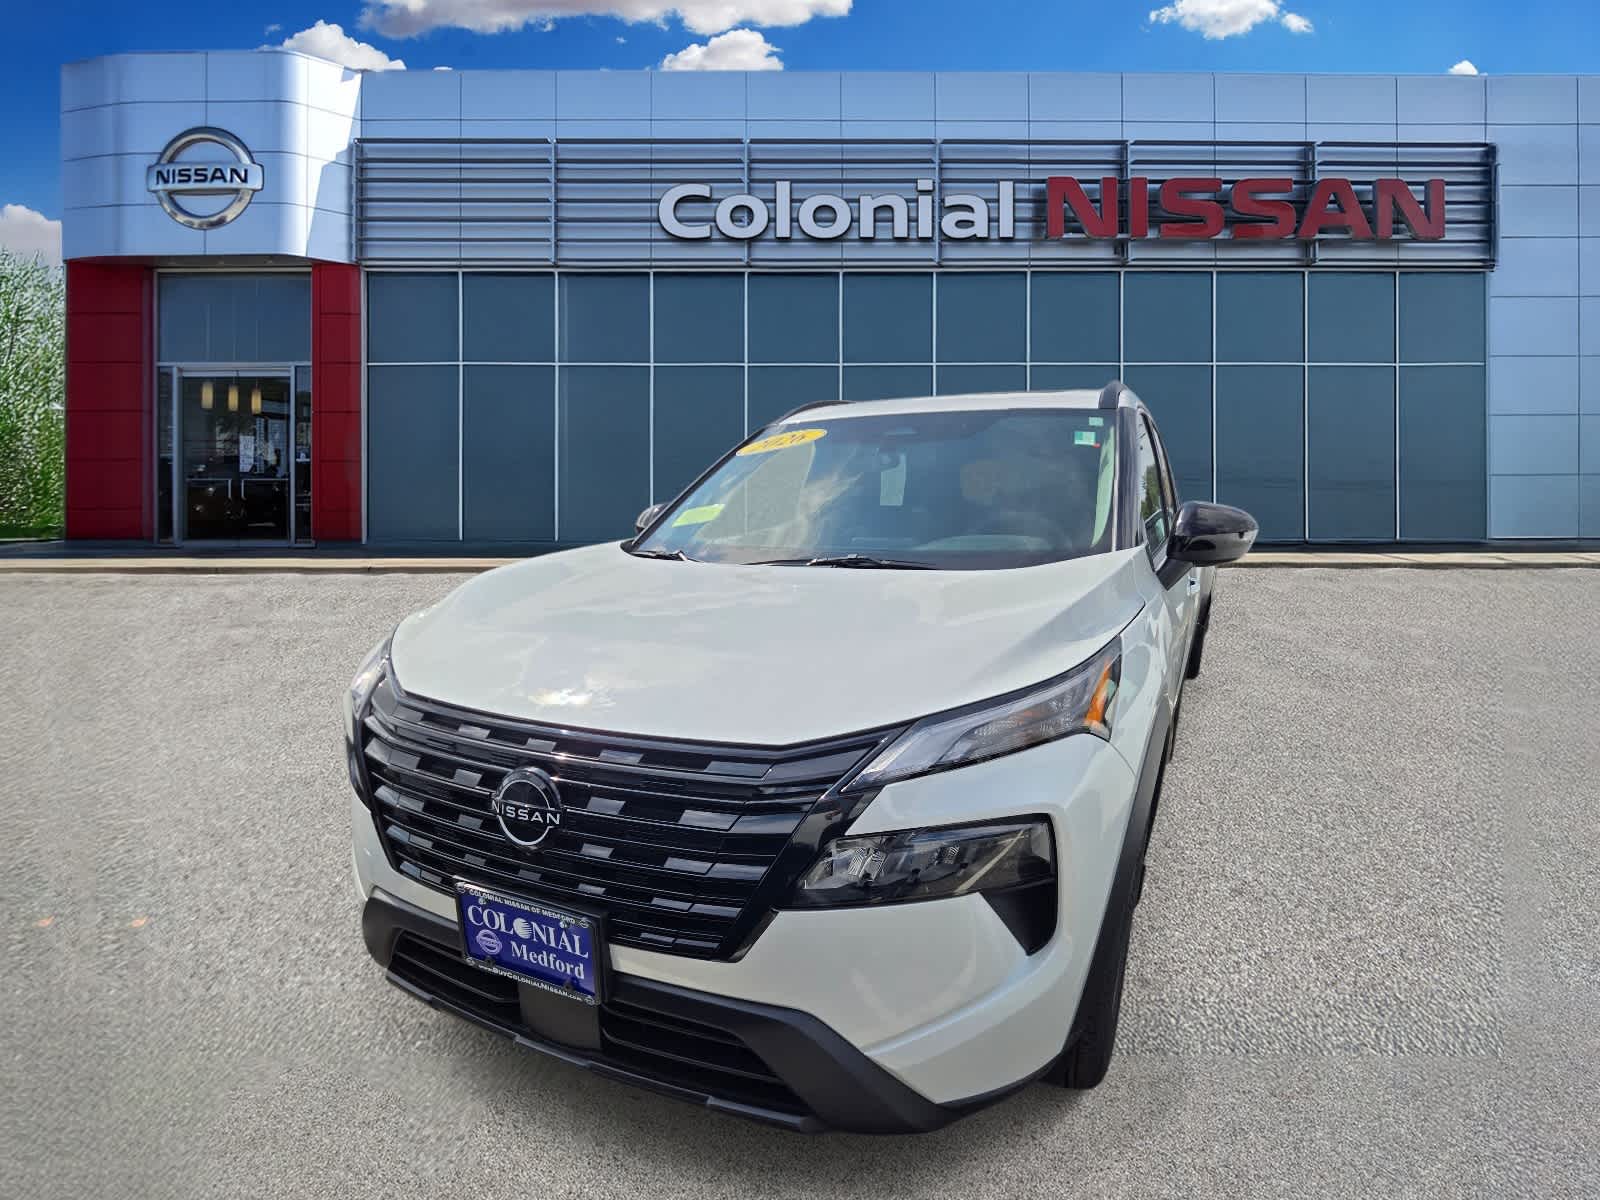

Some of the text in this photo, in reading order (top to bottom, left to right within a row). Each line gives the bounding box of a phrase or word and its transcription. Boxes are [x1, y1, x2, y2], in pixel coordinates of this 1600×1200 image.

[156, 167, 248, 184] NISSAN
[658, 176, 1446, 240] Colonial NISSAN
[492, 799, 560, 825] NISSAN
[467, 905, 589, 958] COLONIAL
[510, 941, 585, 979] Medford
